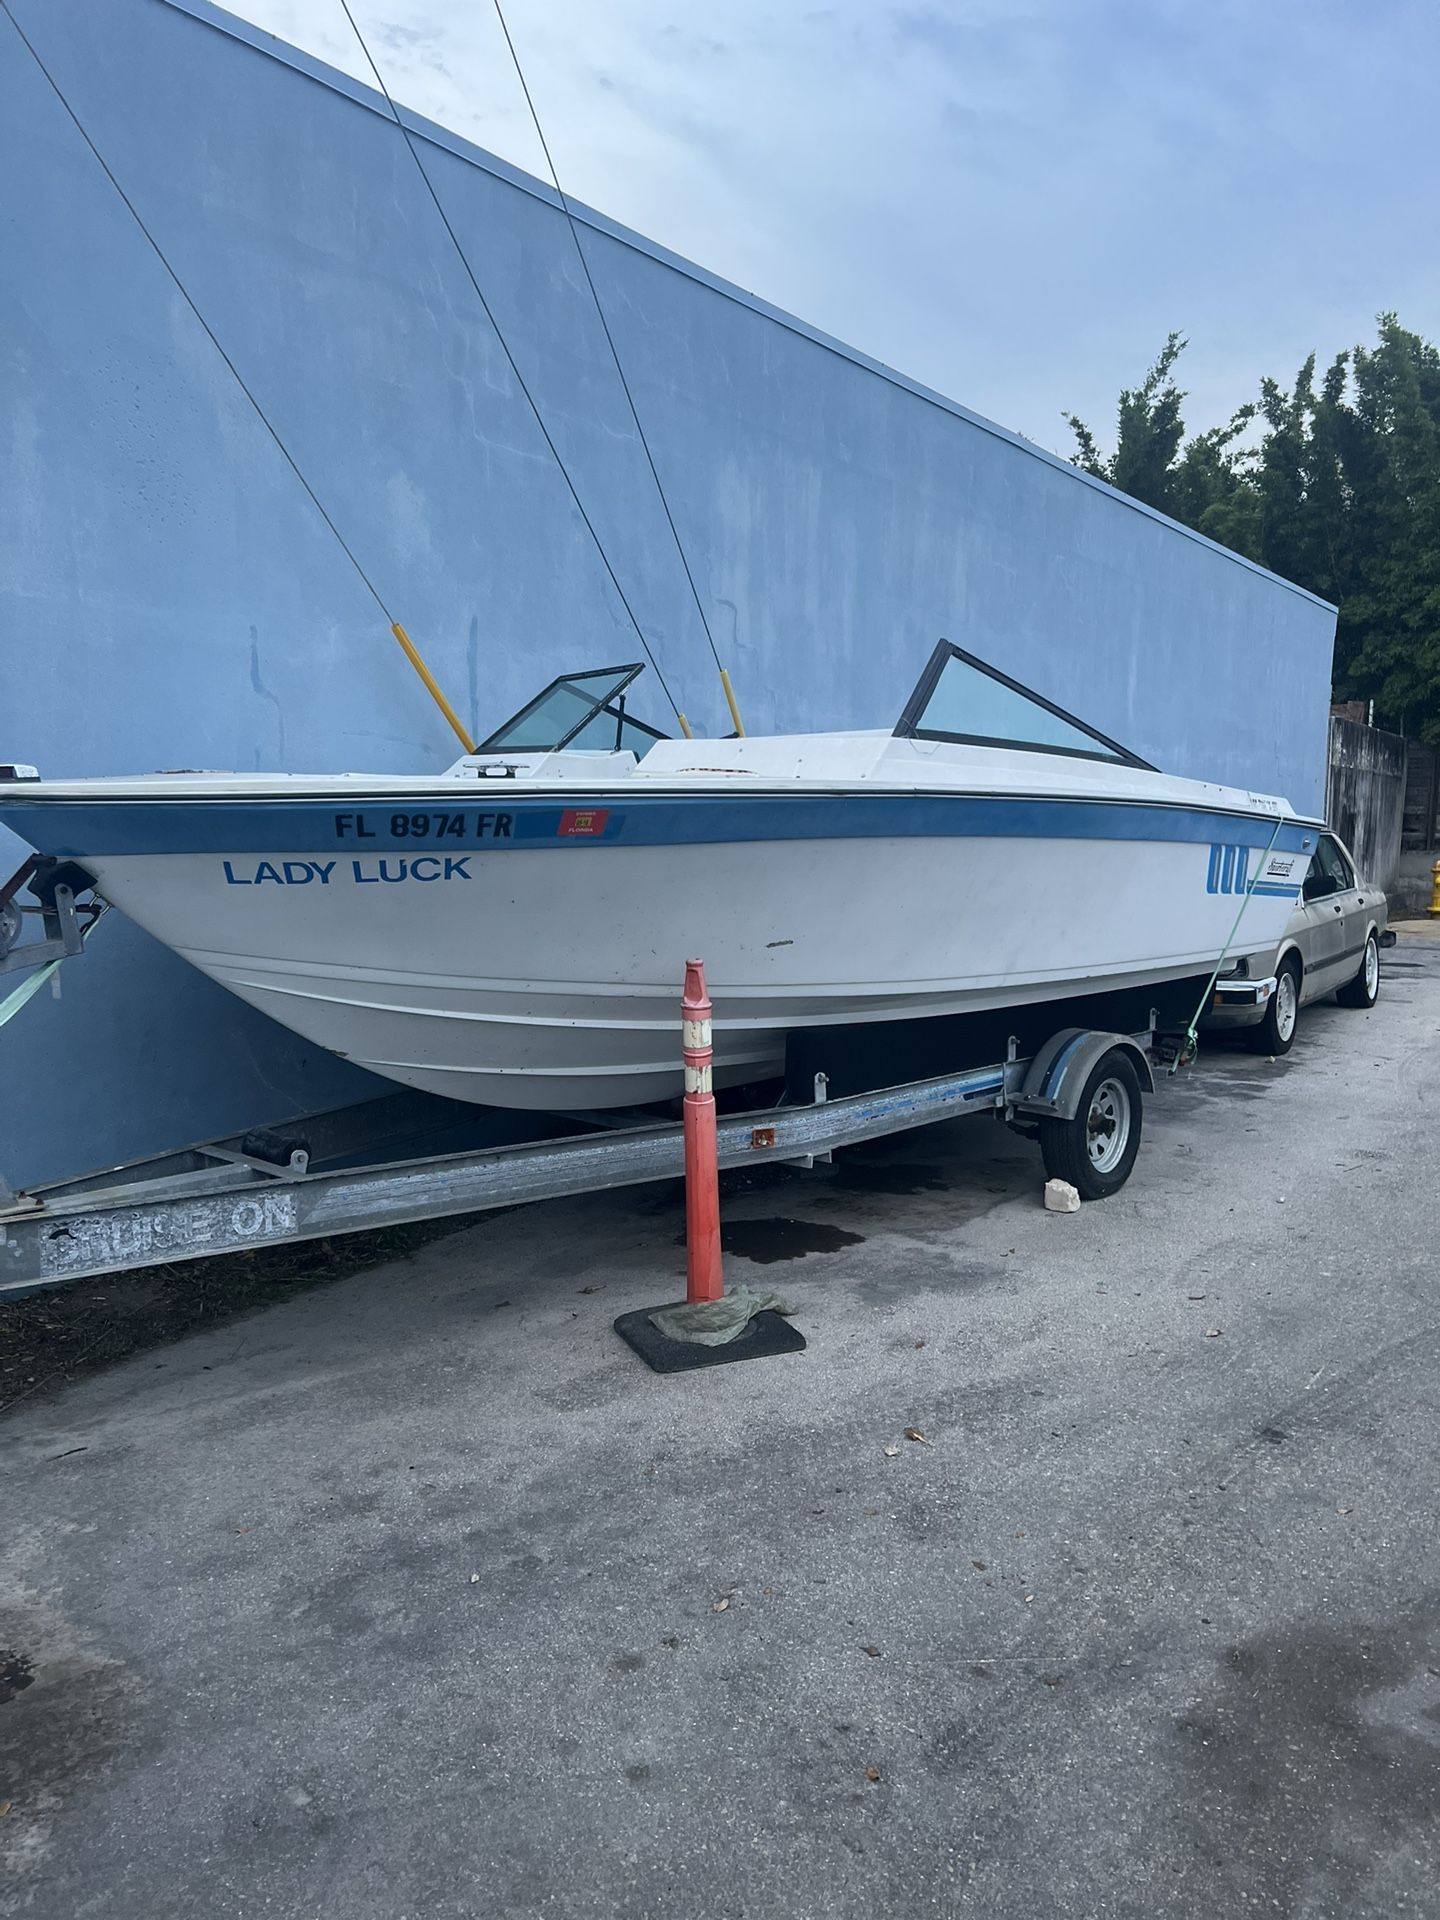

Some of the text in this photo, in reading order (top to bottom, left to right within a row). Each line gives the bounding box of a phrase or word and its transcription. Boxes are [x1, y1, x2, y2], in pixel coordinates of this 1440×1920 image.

[334, 812, 513, 838] FL 8974 FR
[222, 856, 473, 885] LADY LUCK
[231, 1194, 292, 1236] ON
